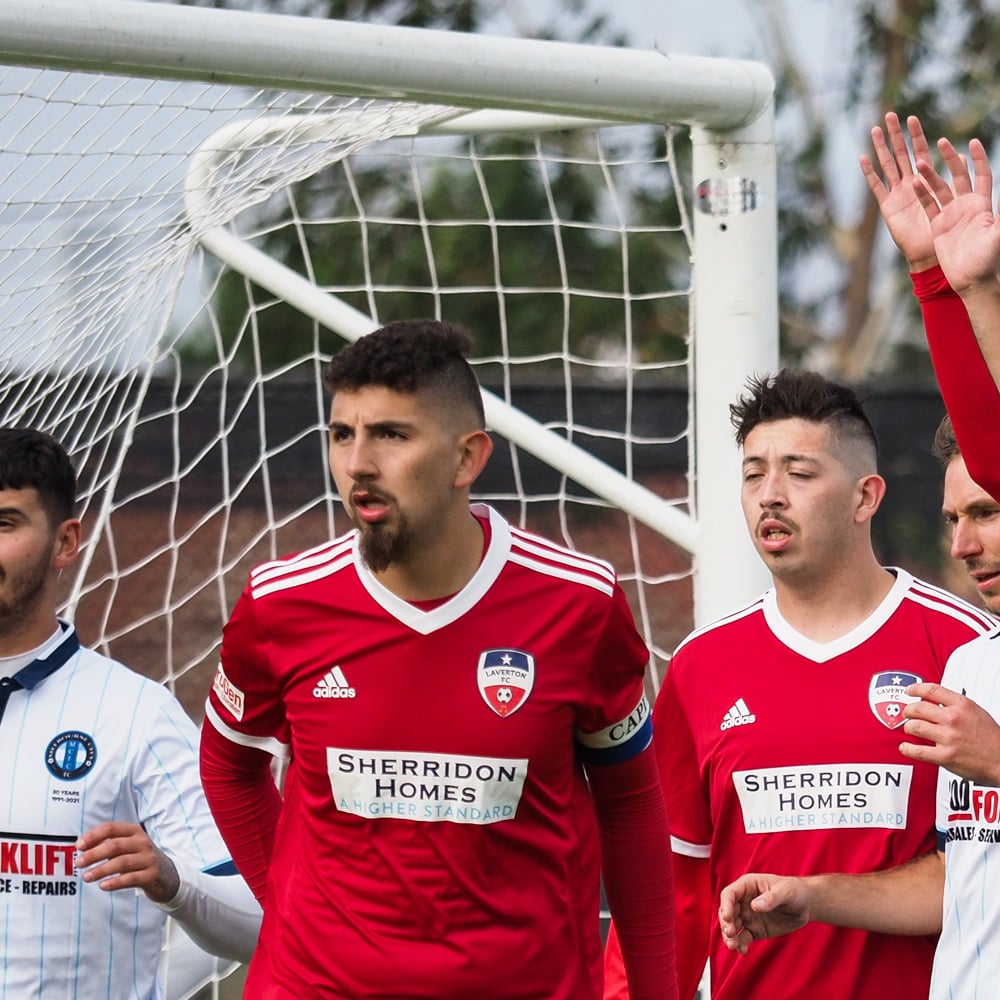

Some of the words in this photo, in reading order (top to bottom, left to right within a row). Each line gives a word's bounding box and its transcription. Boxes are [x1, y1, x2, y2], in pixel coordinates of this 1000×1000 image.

[485, 669, 527, 679] LAVERTON
[312, 686, 356, 699] adidas
[338, 753, 517, 782] SHERRIDON
[744, 770, 902, 792] SHERRIDON
[375, 779, 477, 803] HOMES
[340, 798, 349, 809] A
[354, 800, 417, 816] HIGHER
[424, 804, 514, 821] STANDARD
[778, 793, 868, 811] HOMES
[759, 814, 816, 829] HIGHER
[822, 812, 904, 825] STANDARD
[22, 880, 77, 896] REPAIRS
